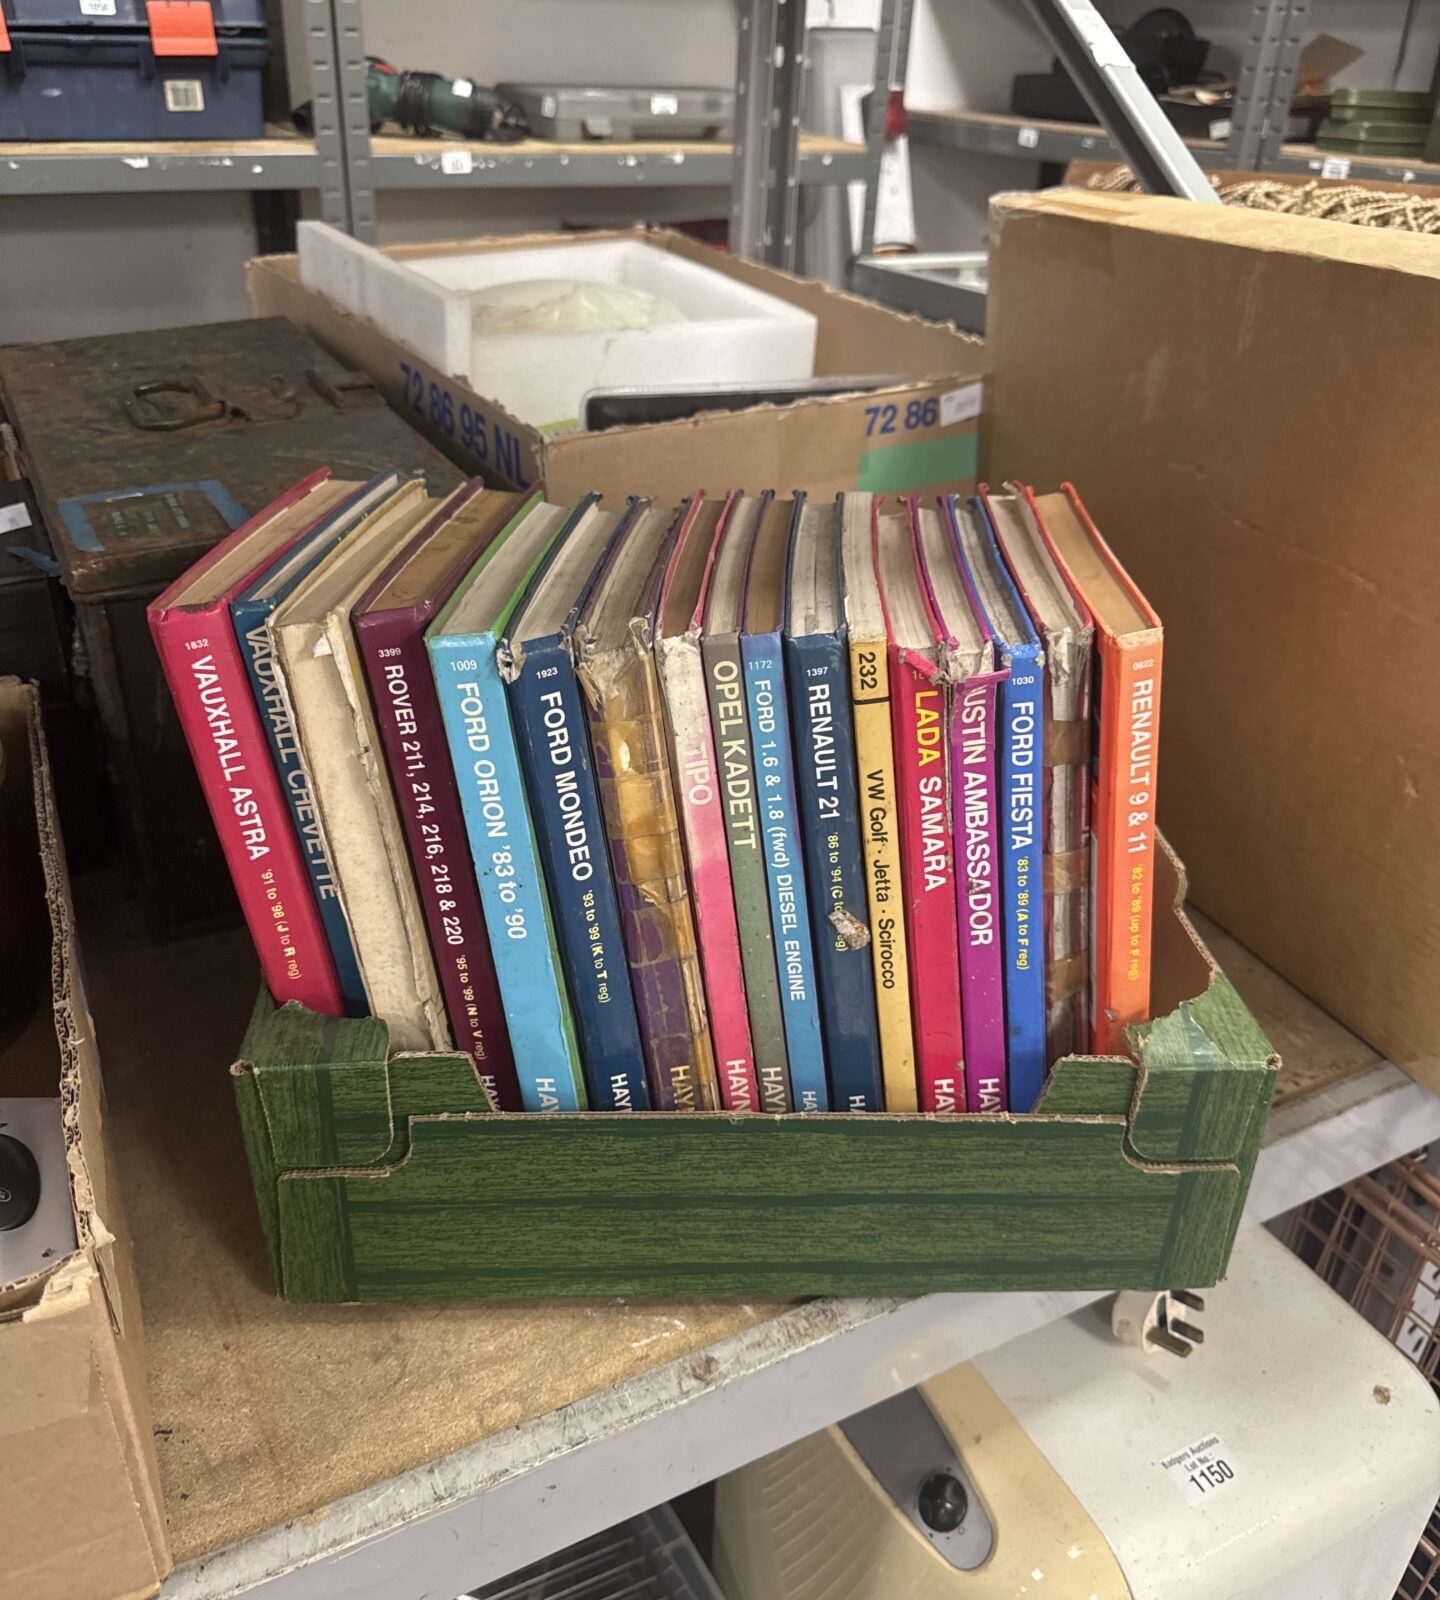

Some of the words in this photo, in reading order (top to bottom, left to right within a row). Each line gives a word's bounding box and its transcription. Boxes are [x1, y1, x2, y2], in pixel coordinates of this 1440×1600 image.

[400, 362, 425, 415] 72
[429, 383, 456, 436] 86
[460, 403, 488, 460] 95
[494, 424, 531, 490] NL
[865, 404, 897, 437] 72
[904, 398, 937, 430] 86
[185, 638, 210, 651] 1832
[378, 647, 402, 658] 3399
[450, 660, 478, 672] 1009
[535, 666, 558, 680] 1923
[748, 660, 773, 670] 1172
[806, 667, 828, 677] 1397
[858, 651, 878, 690] 232
[1012, 676, 1034, 685] 1030
[245, 625, 294, 763] VAUXHALL
[384, 664, 418, 736] ROVER
[713, 660, 743, 736] OPEL
[754, 679, 776, 733] FORD
[191, 655, 246, 782] VAUXHALL
[456, 682, 491, 752] FORD
[540, 691, 572, 765] FORD
[808, 684, 839, 790] RENAULT
[915, 690, 941, 767] LADA
[1011, 702, 1034, 767] FORD
[1130, 679, 1153, 786] RENAULT
[402, 740, 426, 778] 211,
[760, 741, 779, 768] 1.6
[765, 774, 781, 787] &
[867, 768, 885, 801] VW
[412, 782, 436, 820] 214,
[474, 760, 509, 838] ORION
[722, 739, 757, 850] KADETT
[1128, 793, 1149, 805] 9
[767, 794, 785, 820] 1.8
[818, 796, 841, 819] 21
[1011, 773, 1033, 850] FIESTA
[229, 786, 270, 861] ASTRA
[555, 770, 594, 881] MONDEO
[869, 807, 888, 843] Golf
[1127, 811, 1149, 827] &
[421, 824, 444, 861] 216,
[827, 832, 839, 849] '86
[919, 776, 946, 892] SAMARA
[1127, 832, 1148, 853] 11
[767, 826, 791, 868] (fwd)
[492, 845, 515, 877] '83
[829, 851, 840, 863] to
[963, 771, 993, 946] AMBASSADOR
[1017, 855, 1029, 873] '83
[261, 868, 276, 885] '91
[431, 864, 453, 894] 218
[830, 865, 842, 883] '94
[873, 859, 891, 903] Jetta
[1018, 875, 1028, 887] to
[266, 887, 277, 900] to
[498, 881, 517, 903] to
[830, 885, 844, 899] (C
[1018, 889, 1029, 906] '89
[1131, 882, 1142, 894] to
[439, 900, 457, 912] &
[583, 889, 595, 908] '93
[777, 874, 798, 935] DIESEL
[271, 901, 285, 919] '98
[585, 909, 596, 922] to
[1016, 909, 1030, 922] (A
[275, 920, 289, 933] (J
[443, 916, 464, 945] 220
[504, 908, 528, 940] '90
[588, 922, 600, 940] '99
[1018, 924, 1029, 936] to
[1128, 915, 1141, 933] (up
[280, 934, 291, 945] to
[1017, 938, 1029, 946] F
[1130, 934, 1141, 946] to
[283, 946, 296, 957] R
[590, 942, 604, 957] (K
[878, 918, 896, 989] Scirocco
[1130, 948, 1140, 956] F
[287, 959, 303, 979] reg)
[456, 954, 468, 970] '95
[594, 958, 604, 969] to
[1016, 949, 1030, 970] reg)
[459, 972, 470, 983] to
[597, 970, 608, 979] T
[784, 940, 806, 1001] ENGINE
[1128, 959, 1139, 980] reg)
[463, 985, 475, 1001] '99
[597, 982, 612, 1003] reg)
[465, 1003, 479, 1016] (N
[469, 1018, 480, 1028] to
[473, 1030, 484, 1039] V
[474, 1041, 489, 1060] reg)
[1189, 1436, 1220, 1455] Auctions
[1184, 1460, 1199, 1472] Lot
[1189, 1459, 1234, 1493] 1150
